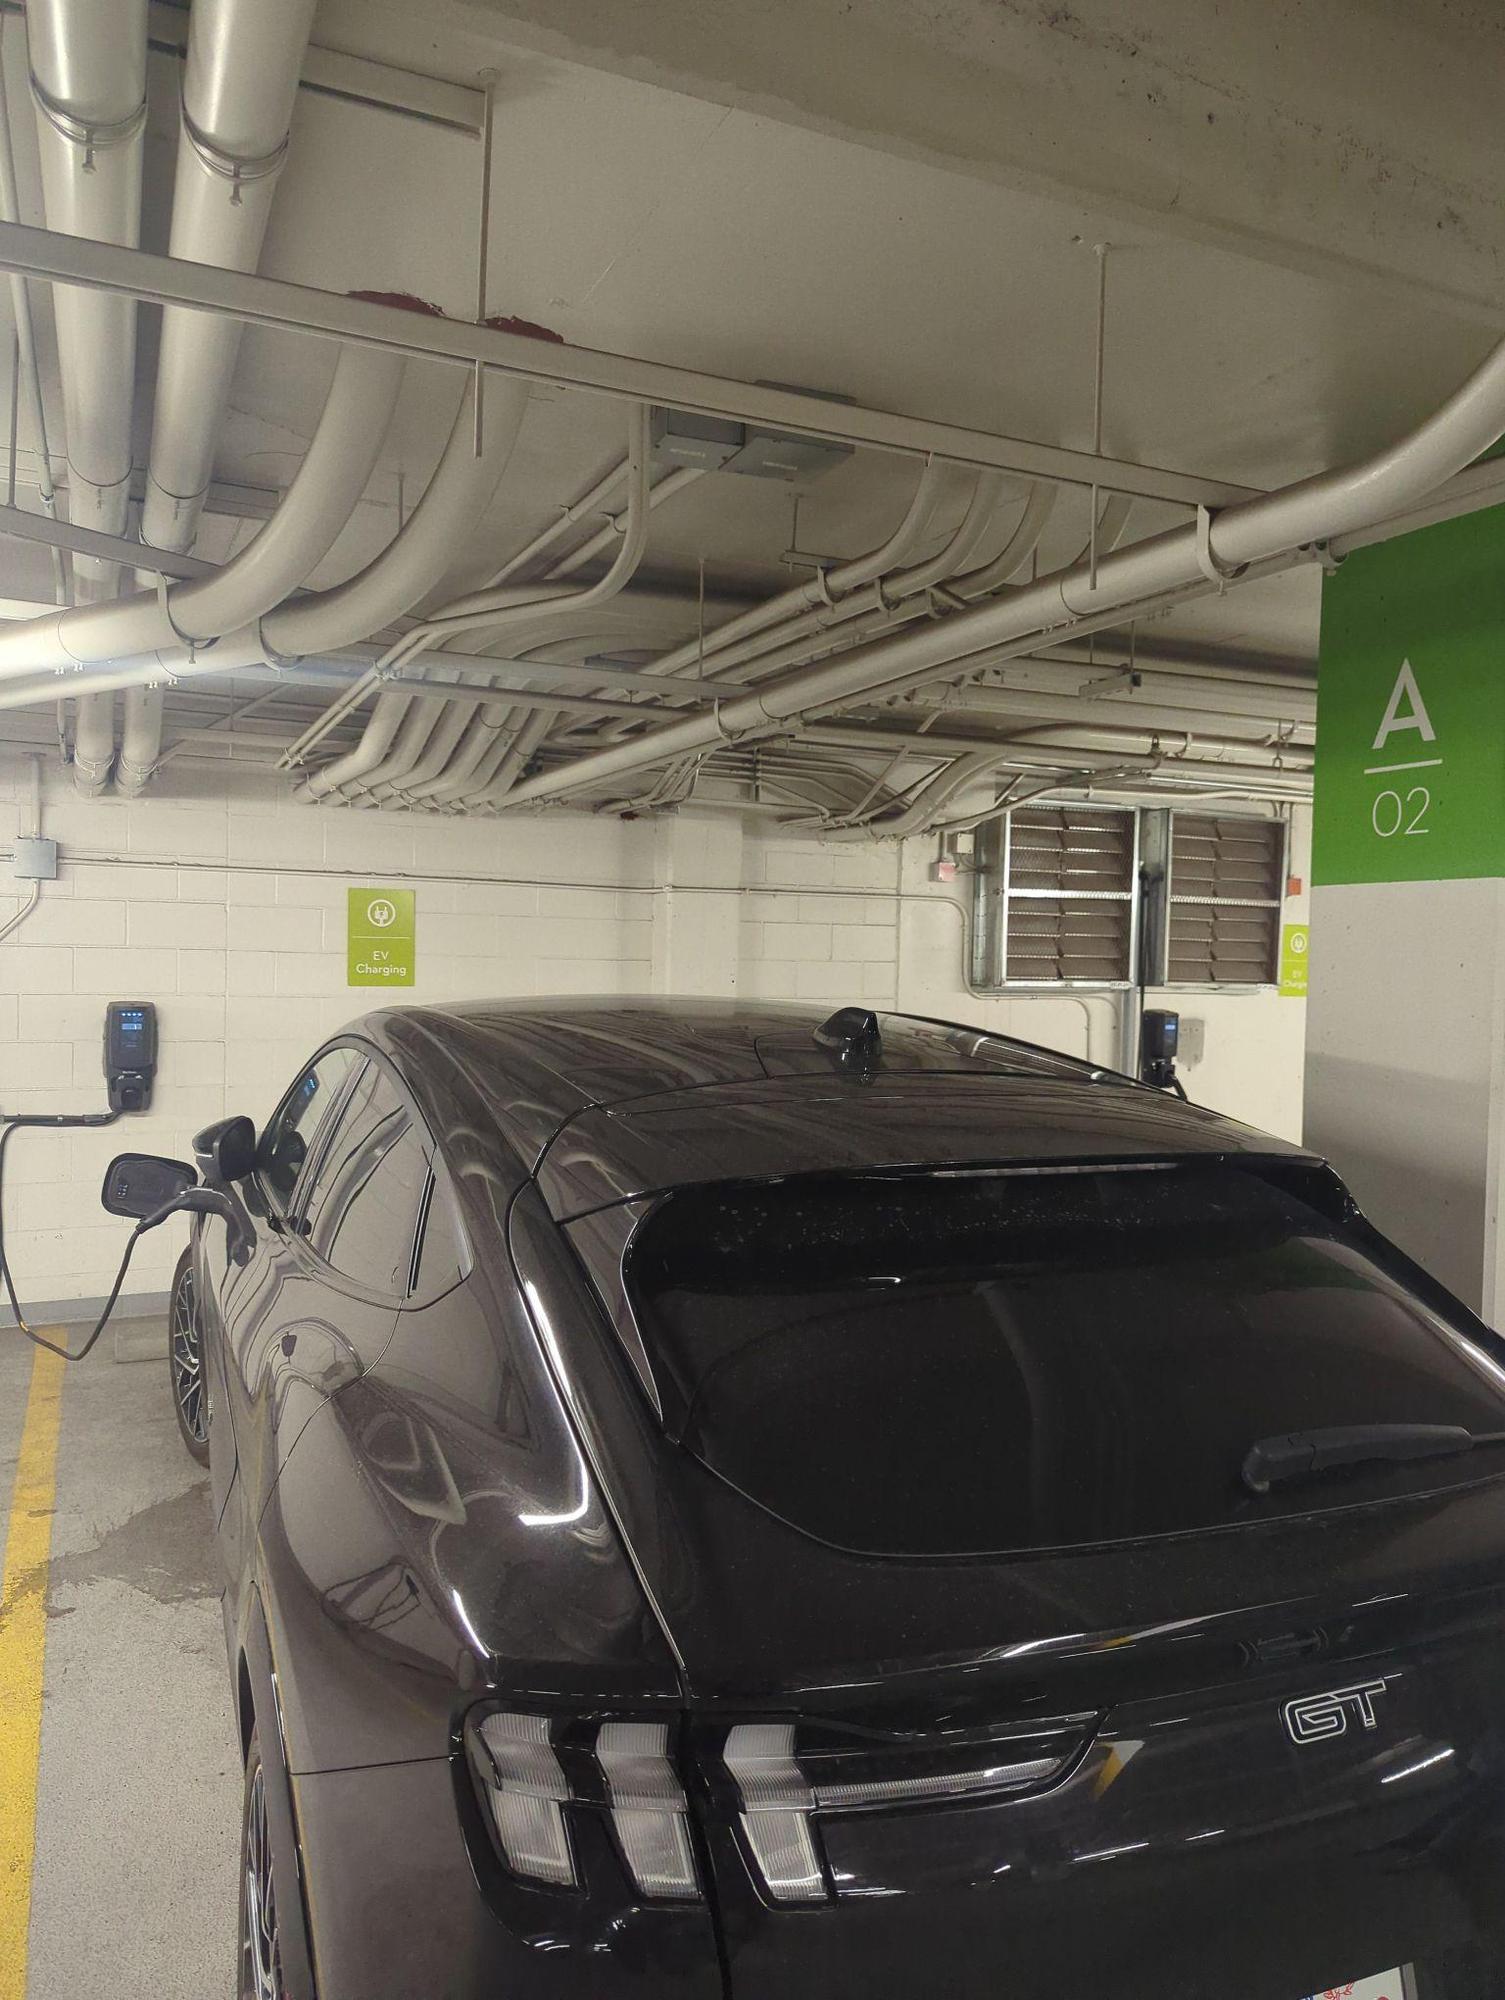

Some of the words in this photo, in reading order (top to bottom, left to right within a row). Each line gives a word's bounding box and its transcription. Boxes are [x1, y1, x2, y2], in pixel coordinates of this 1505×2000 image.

[1372, 657, 1436, 749] A
[1372, 787, 1430, 837] 02
[356, 963, 407, 977] Charging
[373, 950, 389, 961] EV
[1284, 1678, 1387, 1744] GT
